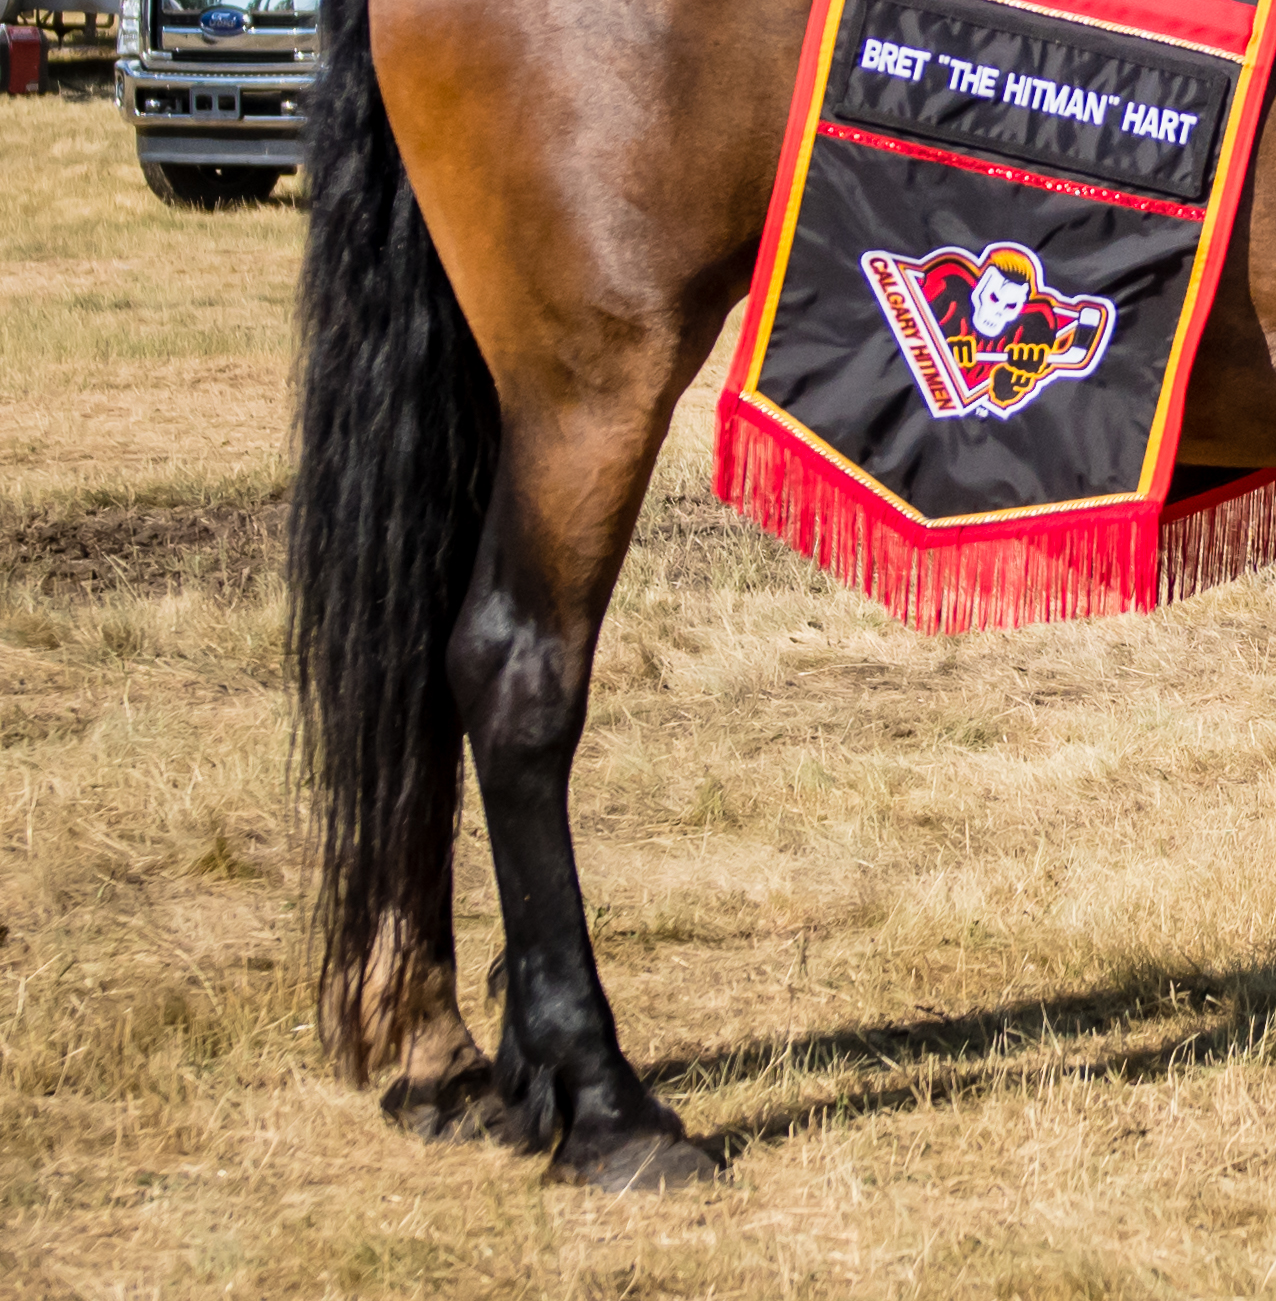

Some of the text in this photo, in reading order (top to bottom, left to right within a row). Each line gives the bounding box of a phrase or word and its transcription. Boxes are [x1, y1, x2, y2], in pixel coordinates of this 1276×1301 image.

[860, 38, 1199, 146] BRET "THE HITMAN" HART
[868, 257, 958, 412] CALGARY HITMEN
